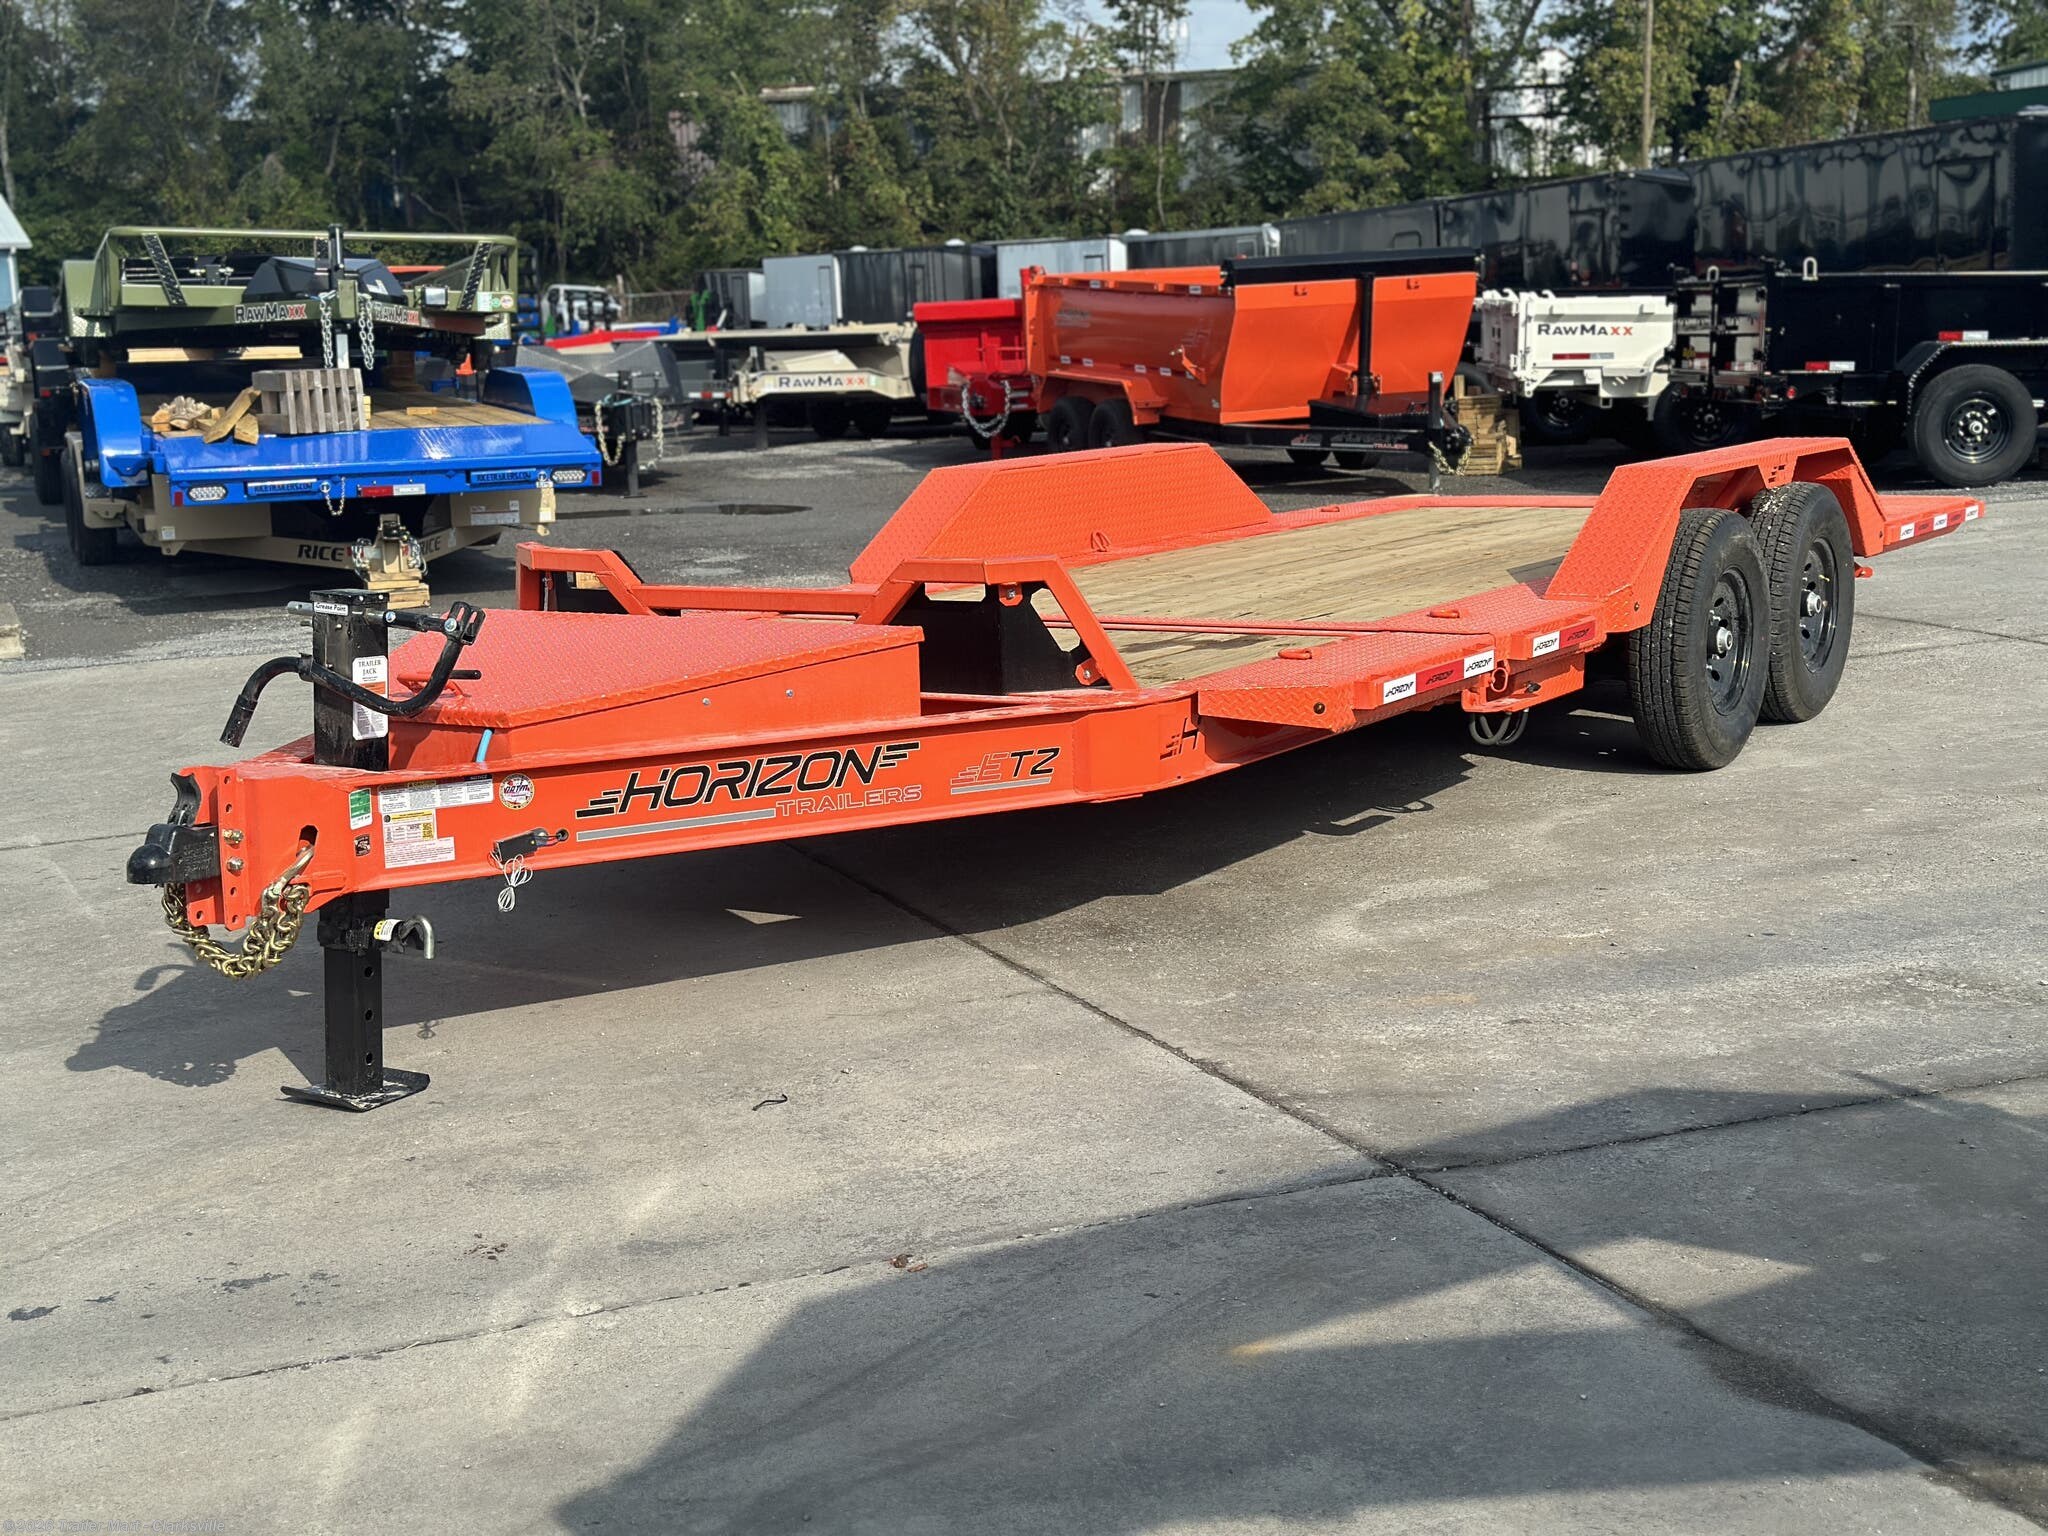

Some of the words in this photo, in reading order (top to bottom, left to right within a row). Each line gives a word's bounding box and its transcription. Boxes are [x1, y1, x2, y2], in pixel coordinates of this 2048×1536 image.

[298, 544, 344, 562] RICE
[315, 602, 333, 610] Grease
[358, 660, 382, 668] TRAILER
[362, 668, 377, 676] JACK
[617, 741, 920, 816] HORIZON
[775, 784, 922, 818] TRAILERS
